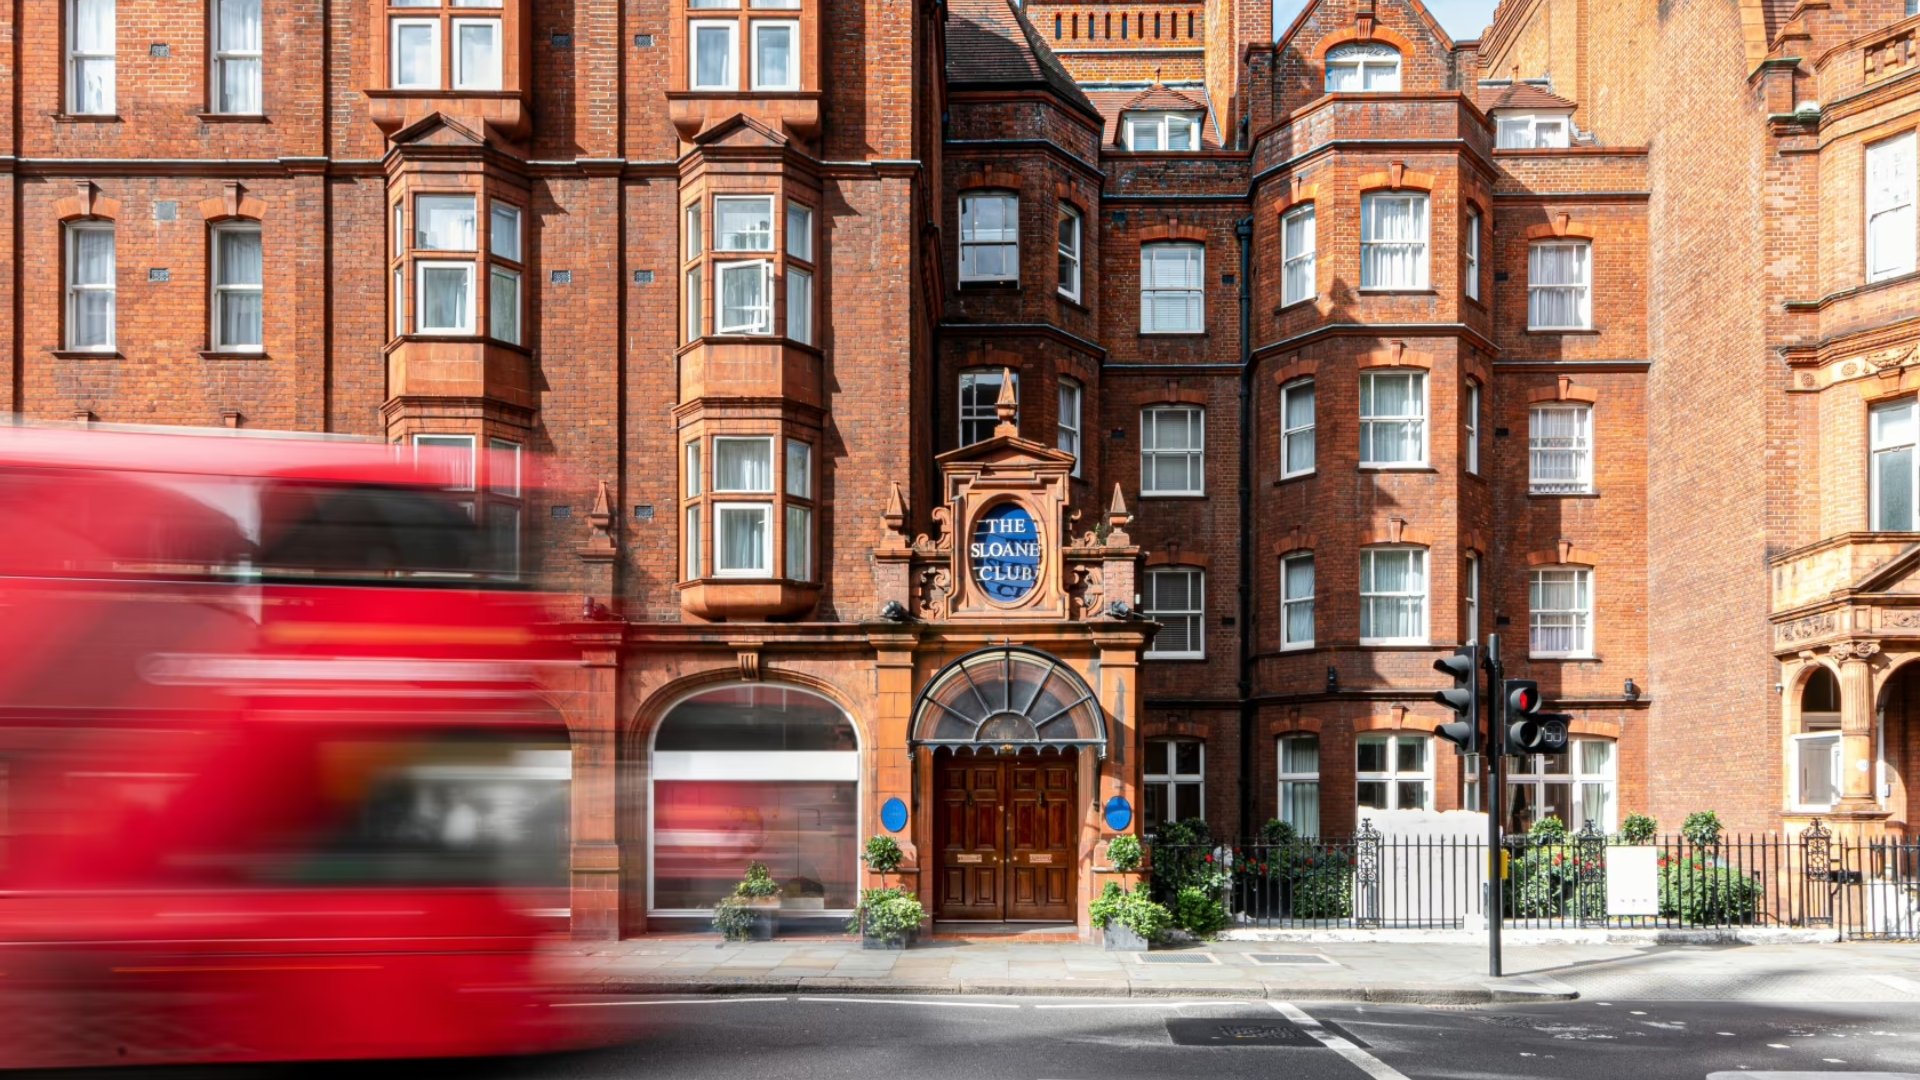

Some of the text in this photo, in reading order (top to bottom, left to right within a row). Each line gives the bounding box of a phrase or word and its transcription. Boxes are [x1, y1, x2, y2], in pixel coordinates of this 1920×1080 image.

[986, 519, 1026, 533] THE
[971, 543, 1040, 557] SLOANE
[980, 566, 1032, 580] CLUB
